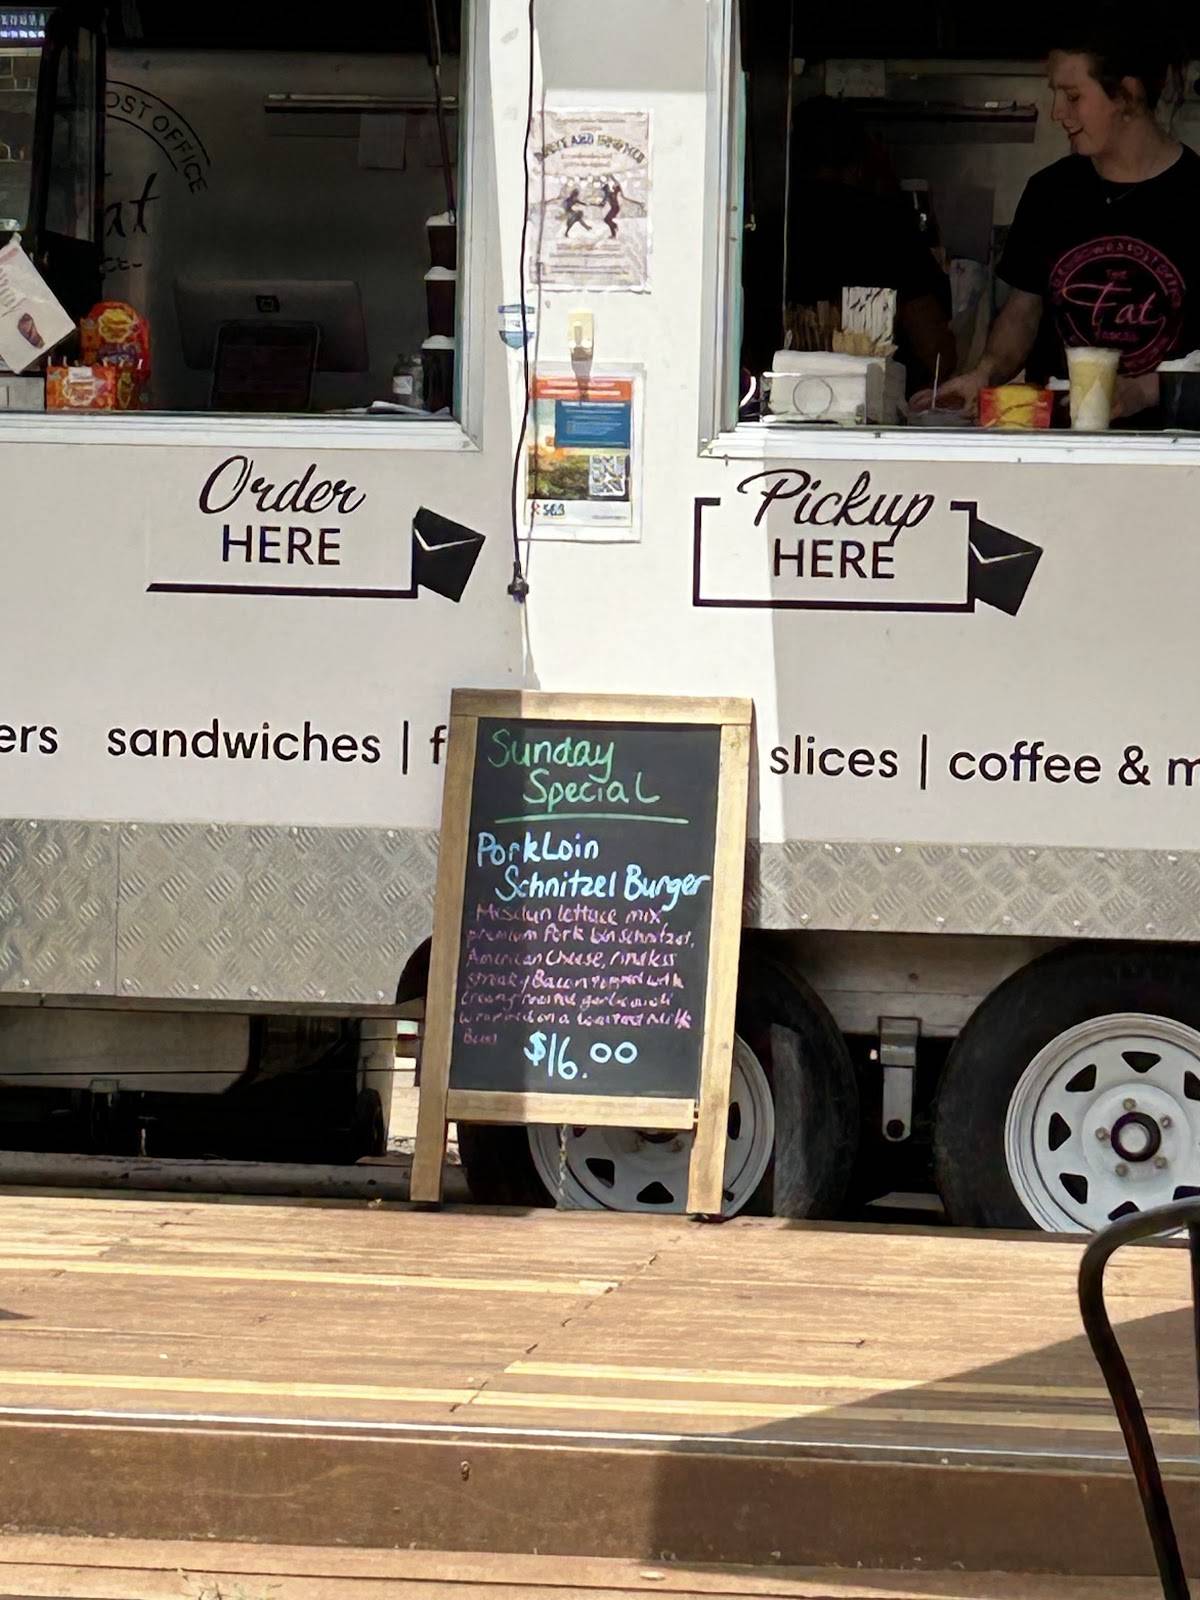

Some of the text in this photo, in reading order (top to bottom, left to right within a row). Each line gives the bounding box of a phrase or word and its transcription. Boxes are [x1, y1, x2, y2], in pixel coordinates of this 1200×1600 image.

[105, 91, 208, 194] OST OFFICE
[1063, 282, 1166, 328] Fat
[199, 455, 366, 514] Order
[737, 469, 935, 542] Pickup
[222, 524, 341, 565] HERE
[774, 538, 895, 579] HERE
[107, 718, 381, 764] sandwiches
[488, 729, 615, 784] Sunday
[769, 735, 898, 778] slices
[949, 740, 1100, 784] coffee
[1118, 745, 1151, 786] &
[495, 864, 711, 912] Schnitzel Burger
